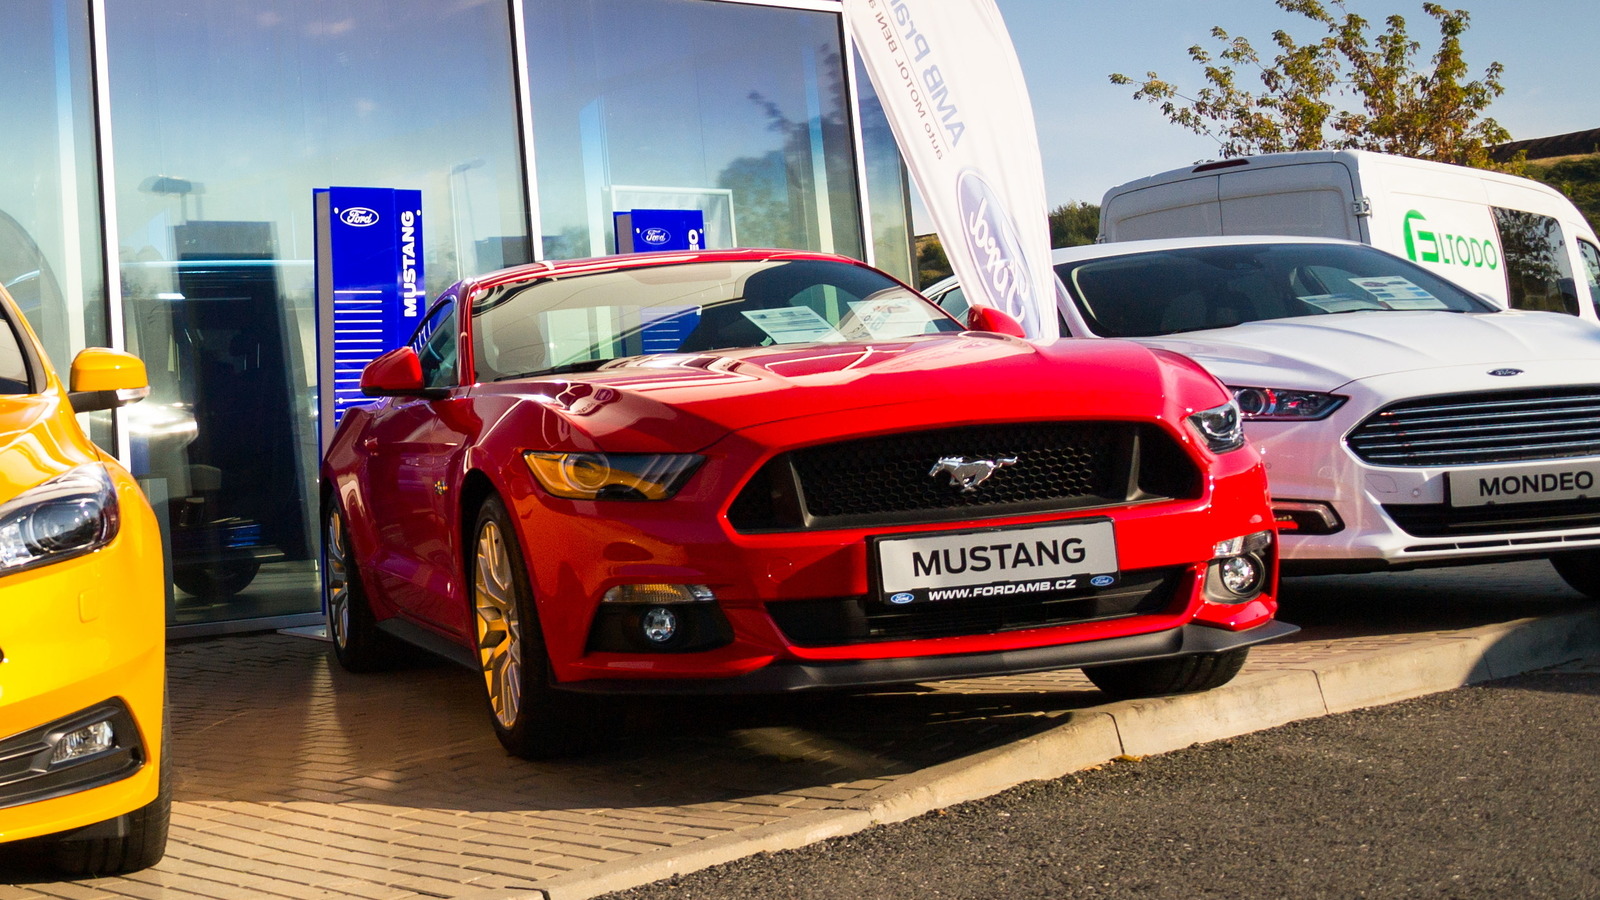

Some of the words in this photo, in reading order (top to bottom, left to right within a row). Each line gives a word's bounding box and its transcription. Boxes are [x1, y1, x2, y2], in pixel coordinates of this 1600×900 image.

[401, 210, 418, 317] MUSTANG
[1479, 471, 1593, 496] MONDEO
[912, 538, 1086, 577] MUSTANG
[928, 579, 1076, 601] WWW.FORDAMB.CZ
